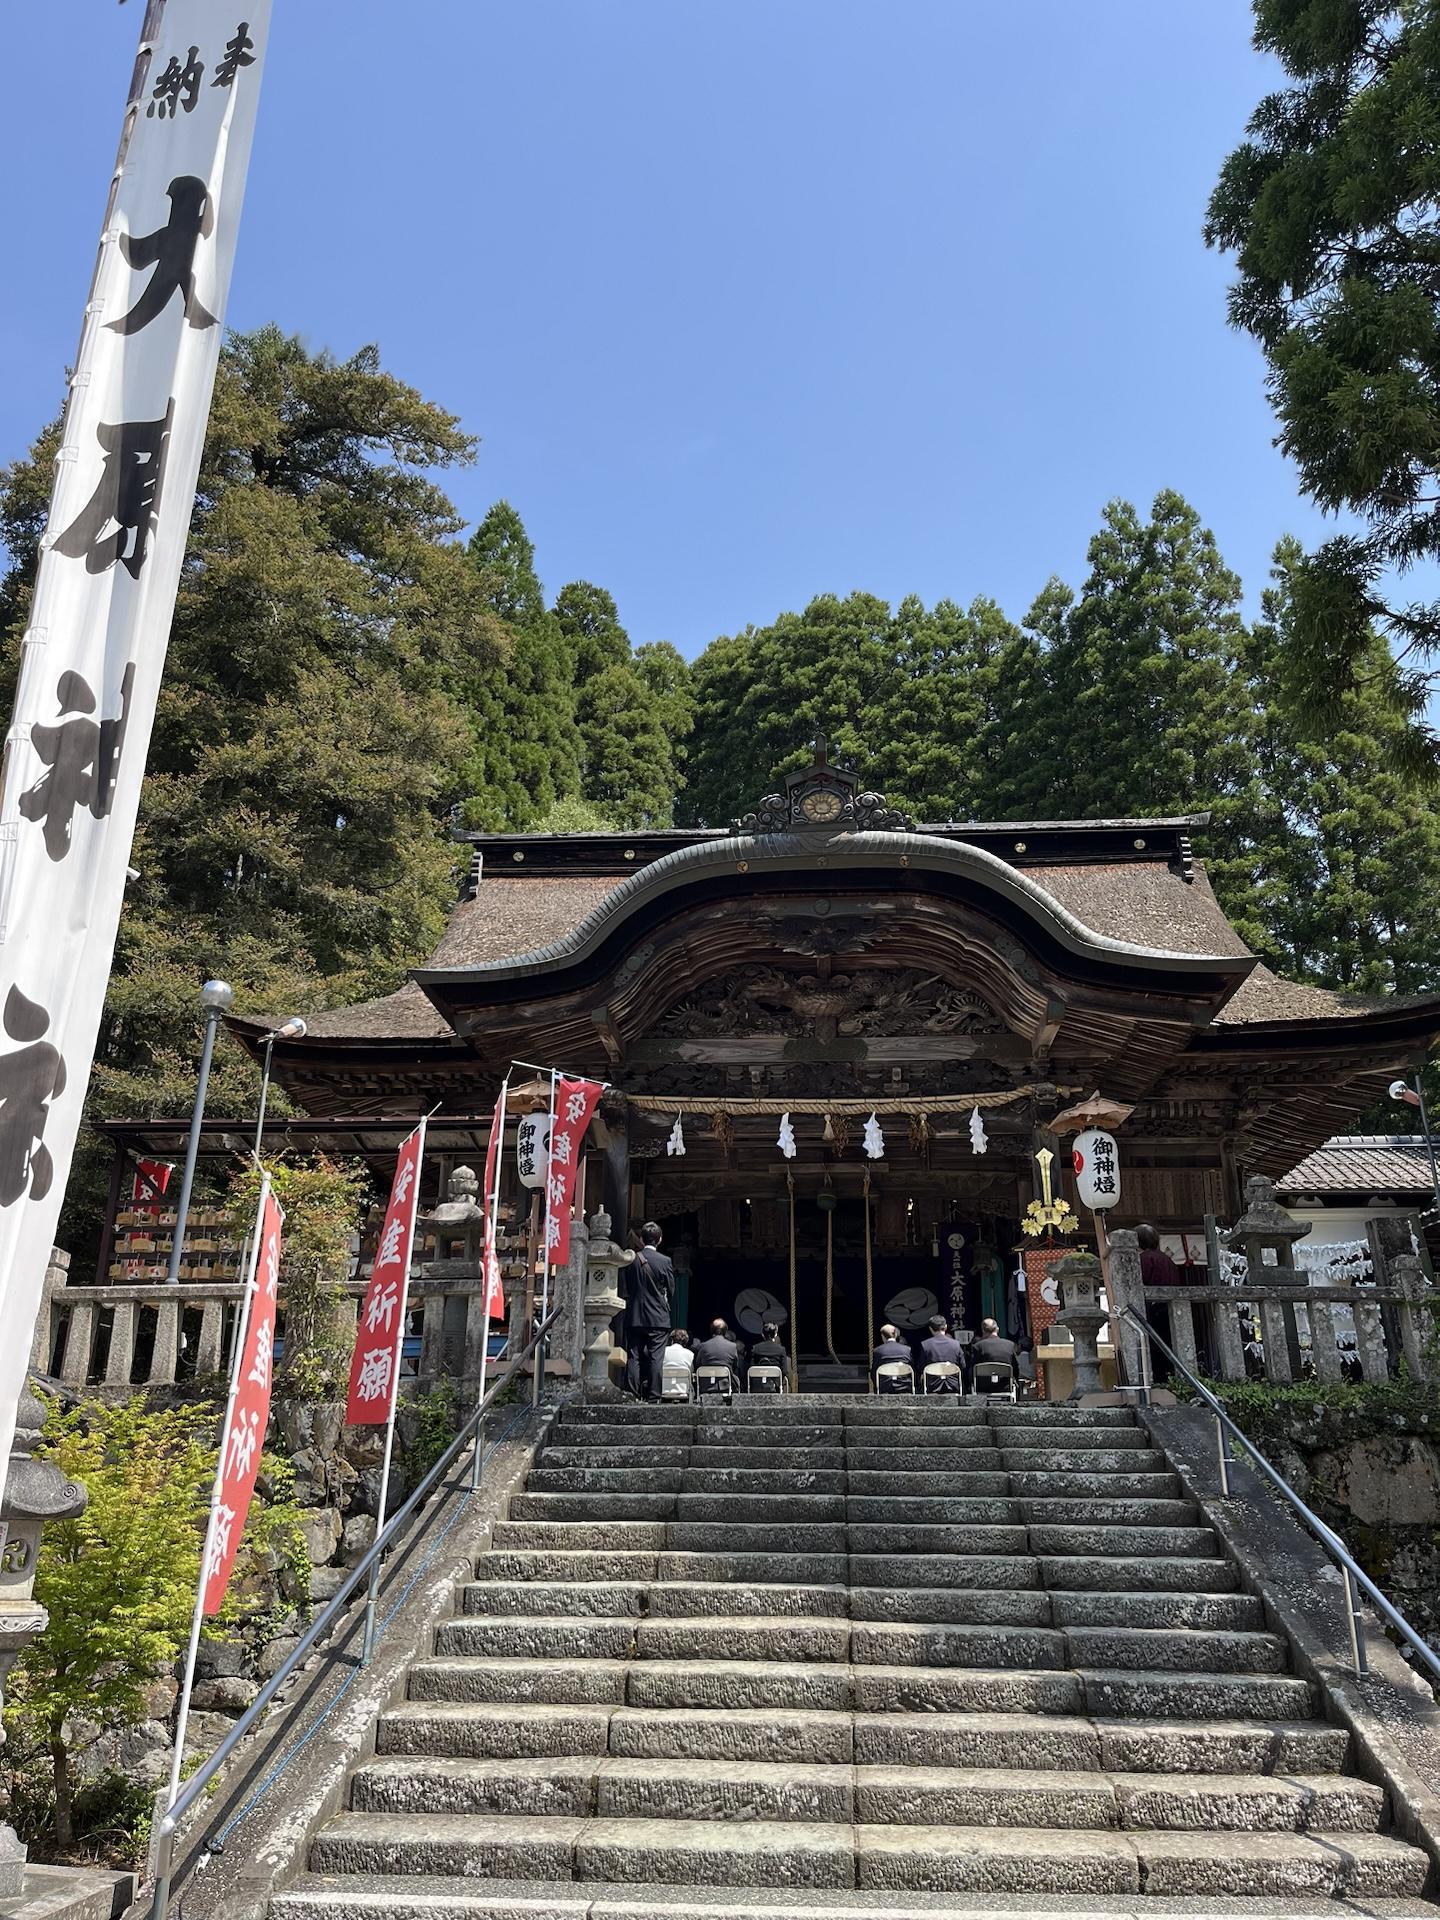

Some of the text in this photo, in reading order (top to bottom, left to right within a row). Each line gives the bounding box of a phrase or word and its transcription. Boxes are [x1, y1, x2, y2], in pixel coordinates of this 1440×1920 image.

[1091, 1136, 1116, 1195] 御神燈
[357, 1157, 414, 1402] 安産祈願
